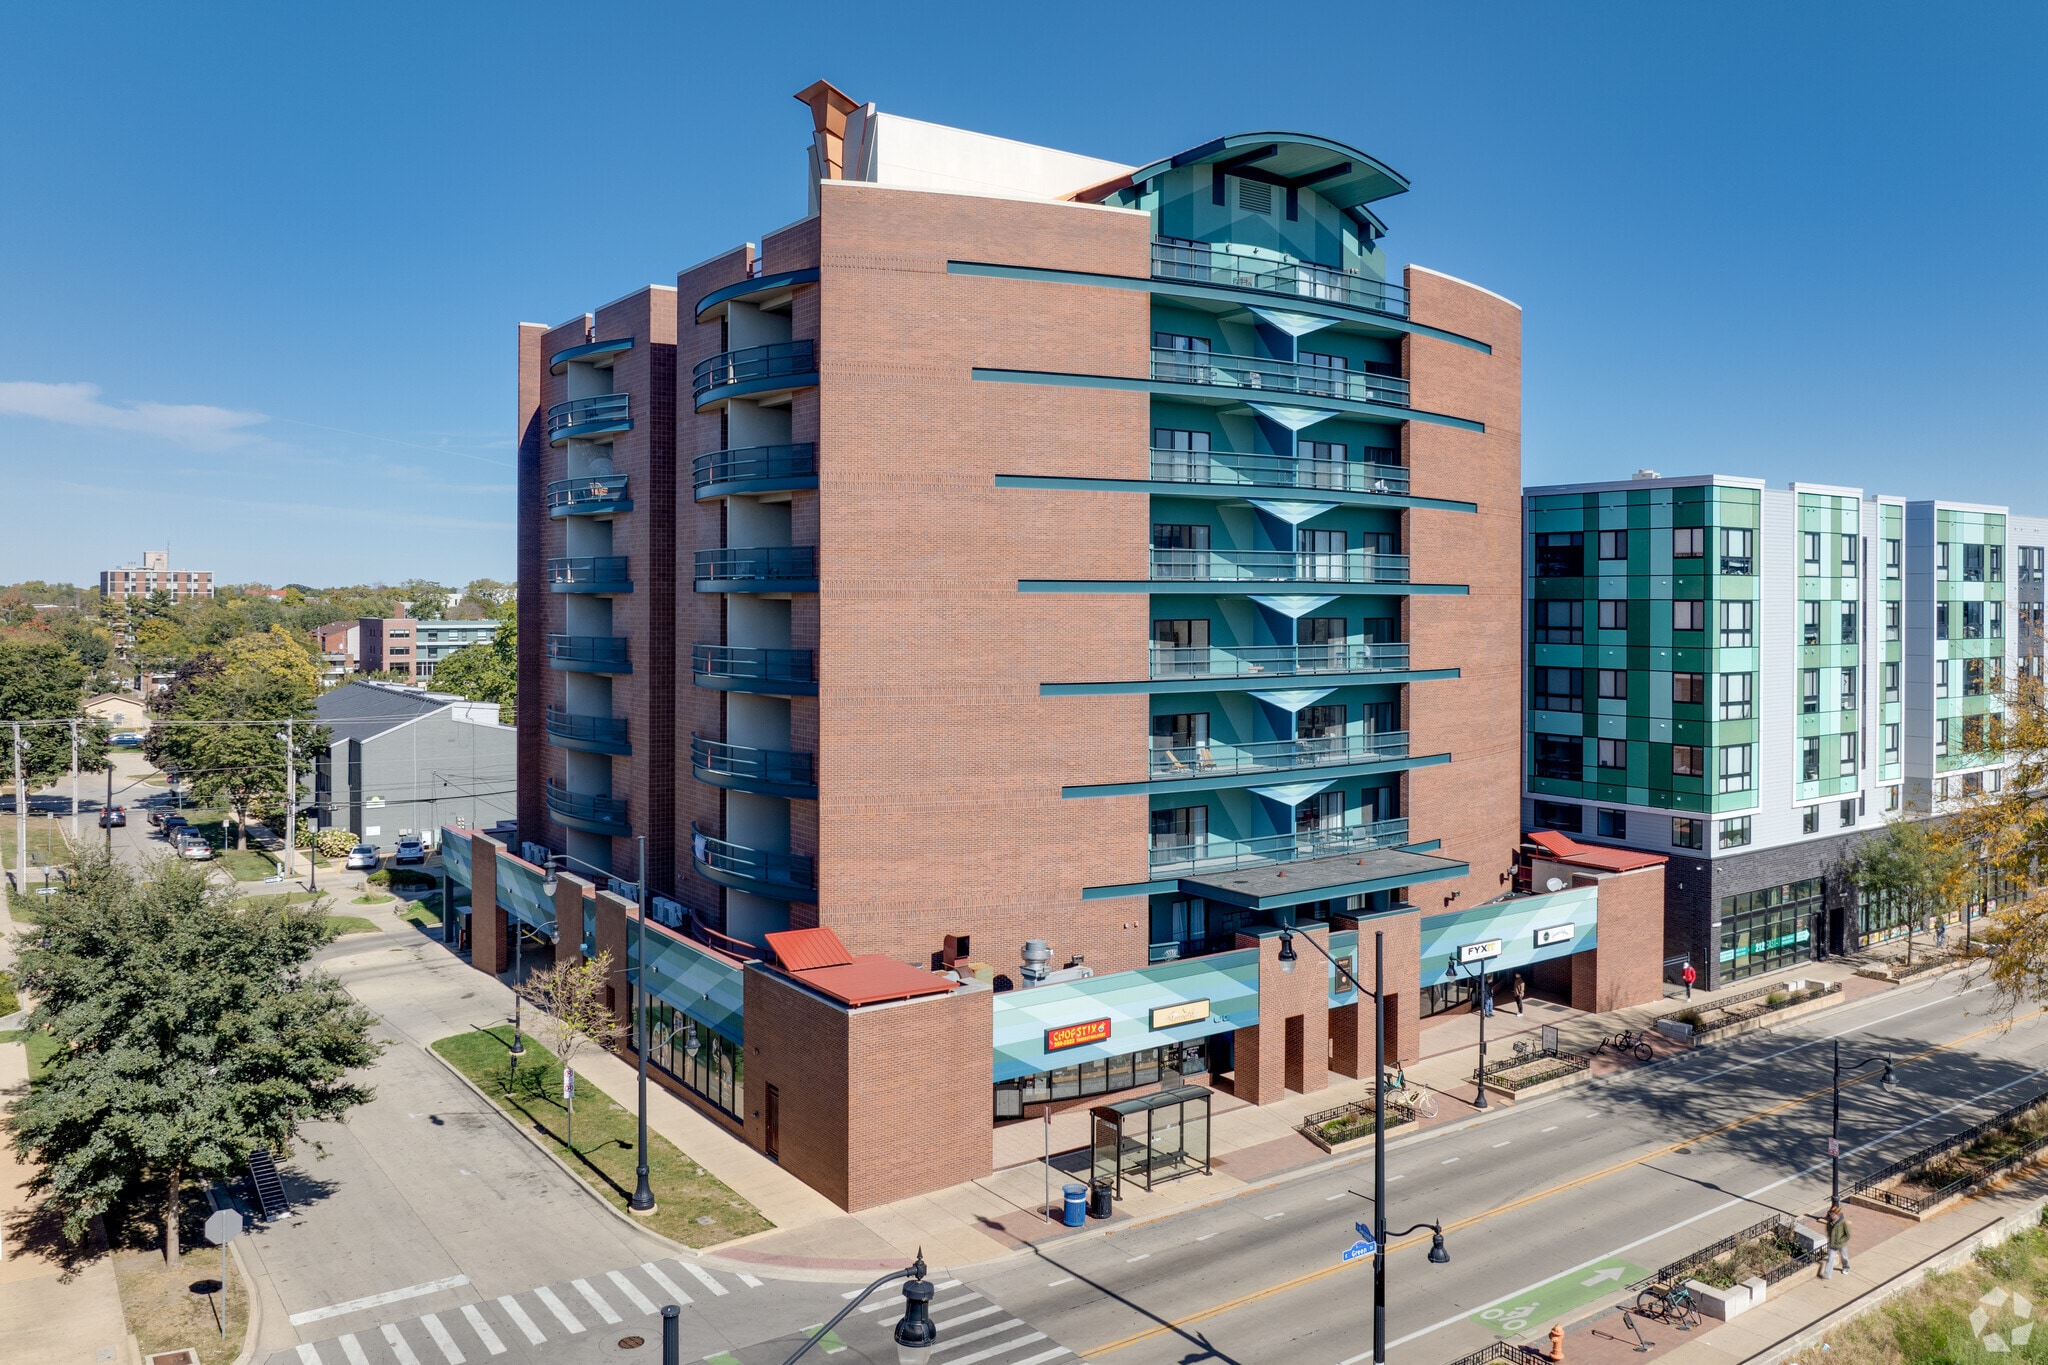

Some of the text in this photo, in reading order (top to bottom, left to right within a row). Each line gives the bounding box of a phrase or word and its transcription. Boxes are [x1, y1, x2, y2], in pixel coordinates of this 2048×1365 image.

[1755, 941, 1766, 953] 212
[1053, 1024, 1097, 1042] CHOPSTIX
[1351, 1247, 1367, 1258] Green
